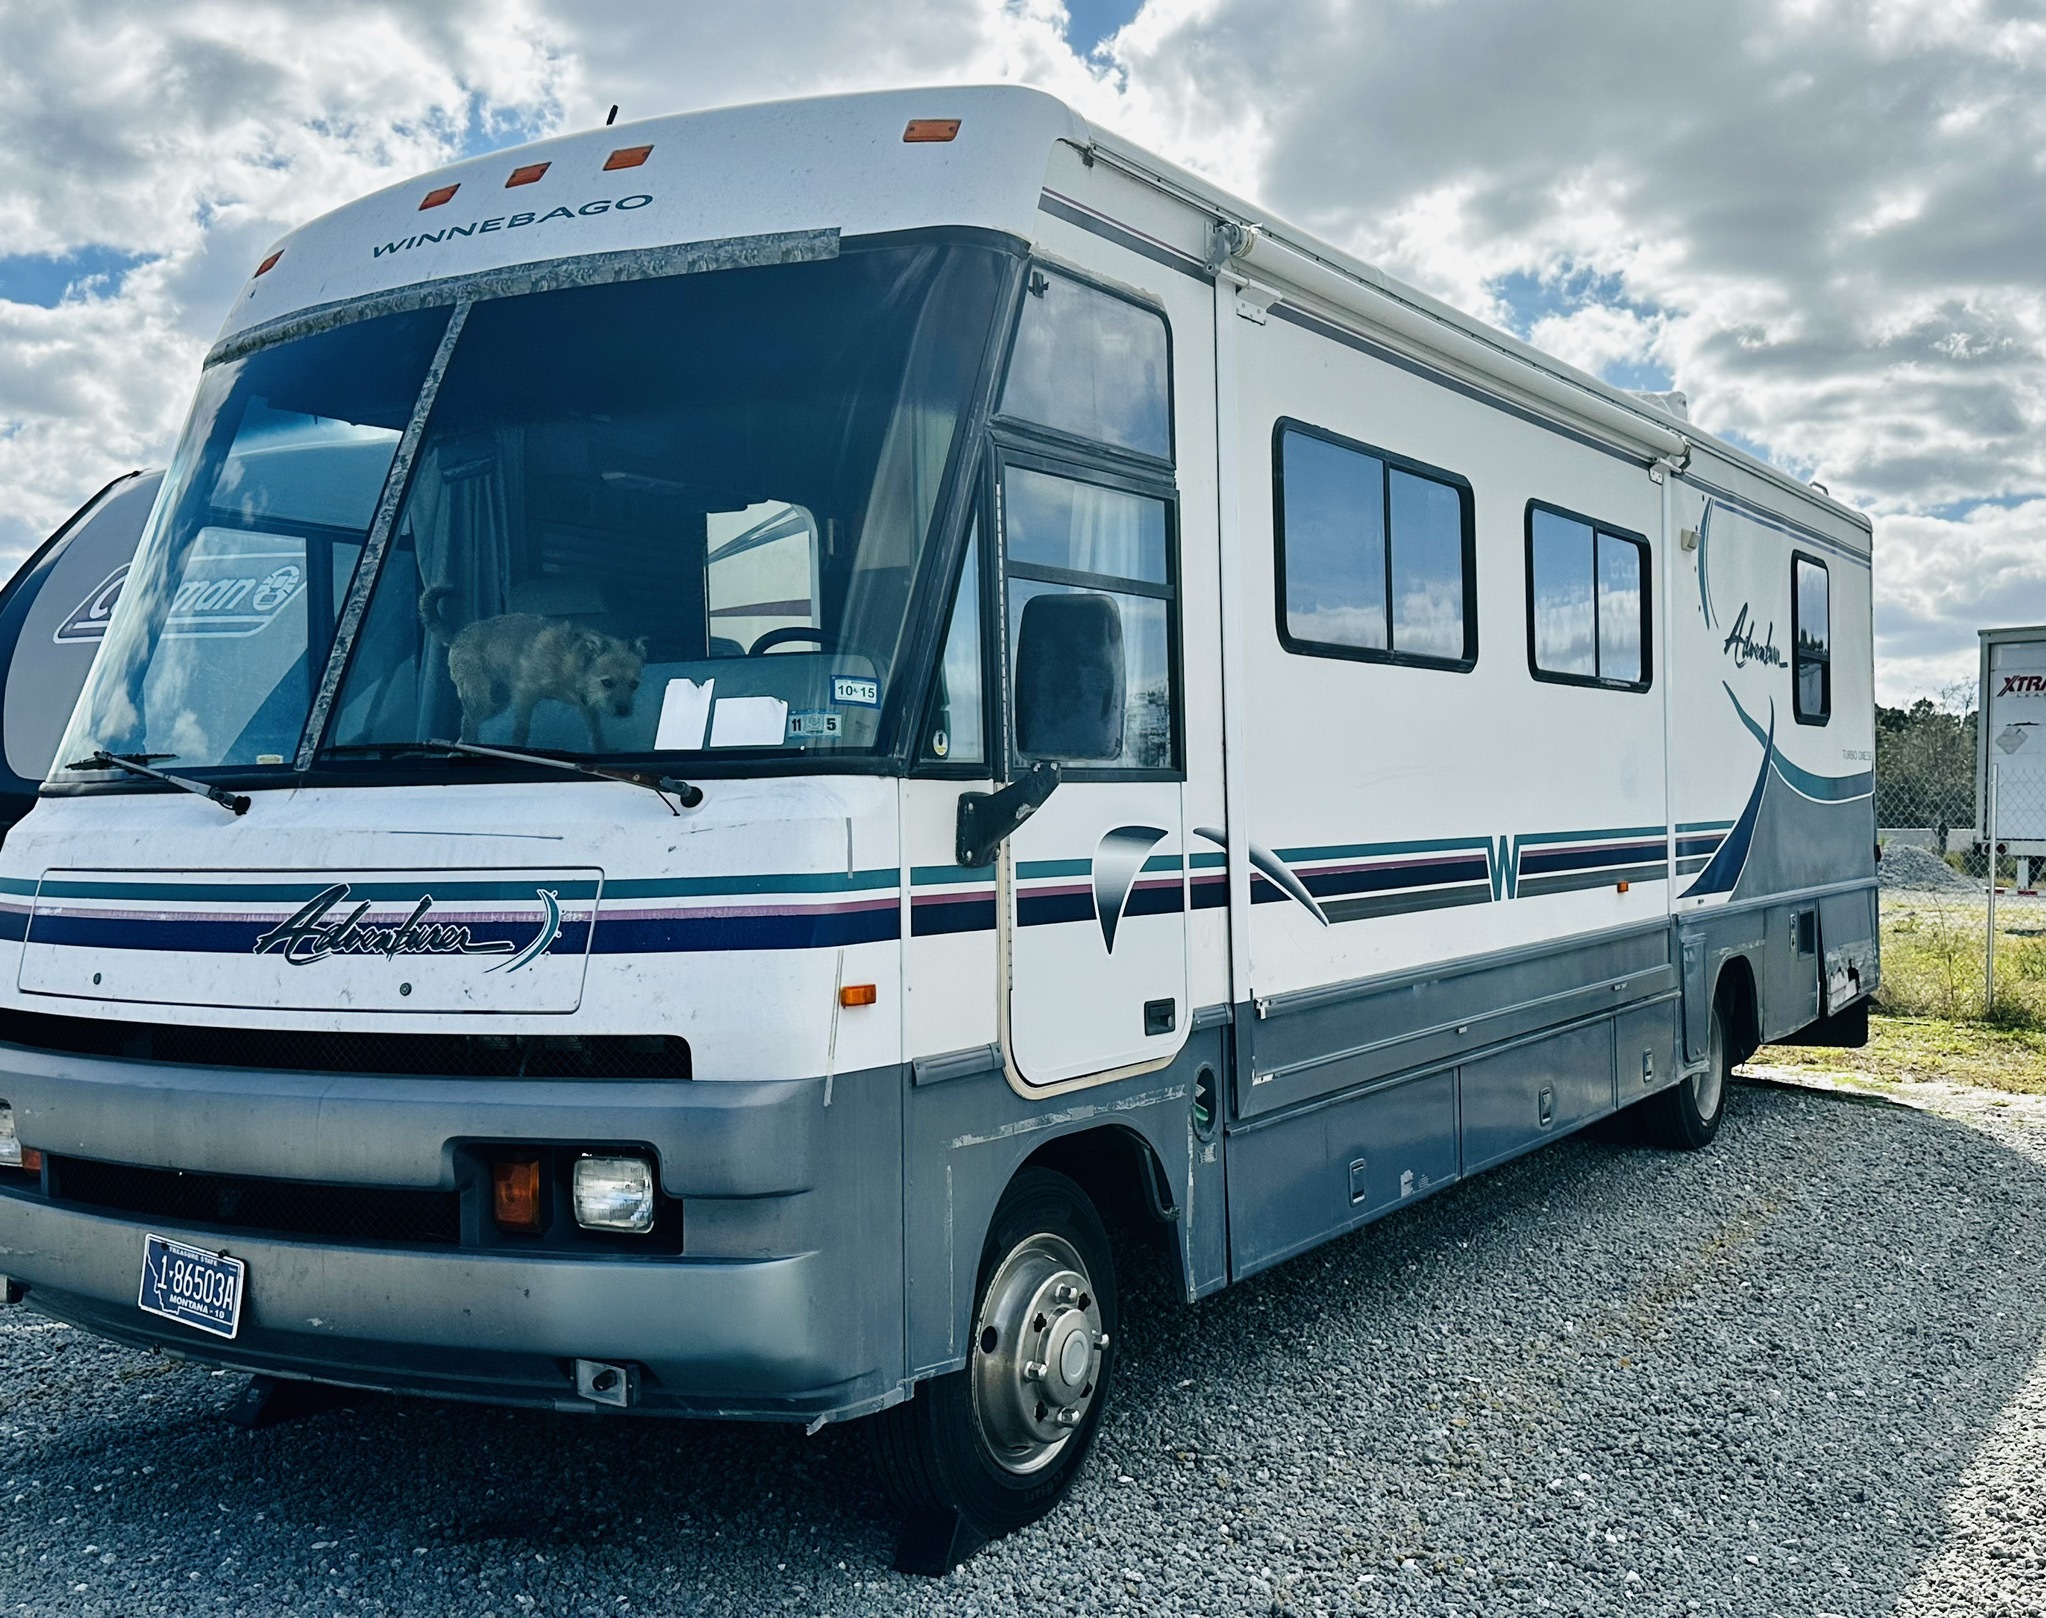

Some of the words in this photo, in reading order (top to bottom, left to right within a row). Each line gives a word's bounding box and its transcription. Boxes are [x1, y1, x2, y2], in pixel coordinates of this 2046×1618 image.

[372, 194, 654, 258] WINNEBAGO
[838, 685, 853, 696] 10
[860, 687, 875, 698] 15
[792, 718, 802, 731] 11
[827, 718, 837, 731] 5
[253, 882, 516, 967] Adventurer
[169, 1247, 199, 1261] TREASURE
[200, 1256, 218, 1266] STATE
[169, 1294, 209, 1314] MONTANA
